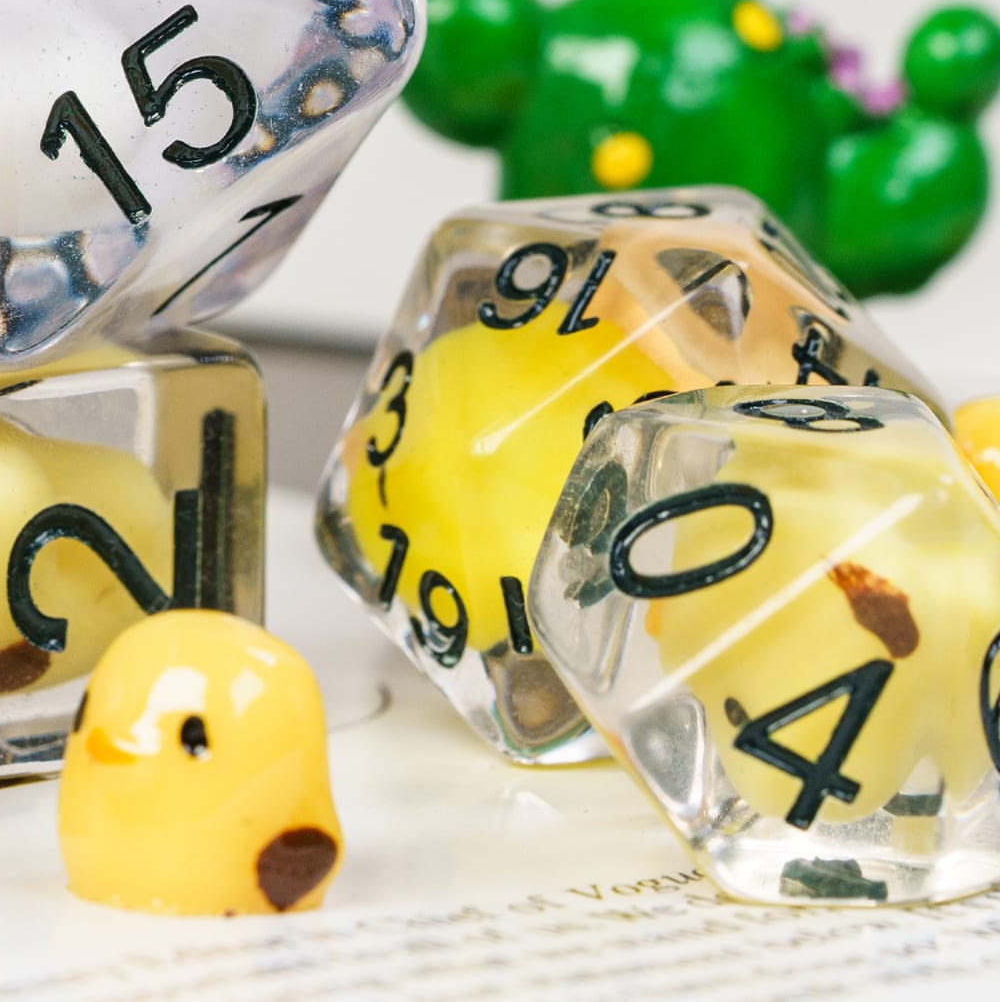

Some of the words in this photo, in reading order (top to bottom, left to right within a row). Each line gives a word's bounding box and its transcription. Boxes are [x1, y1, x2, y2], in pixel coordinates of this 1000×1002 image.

[40, 3, 259, 225] 15
[366, 350, 414, 467] 3
[609, 482, 773, 599] 0
[733, 658, 895, 831] 4
